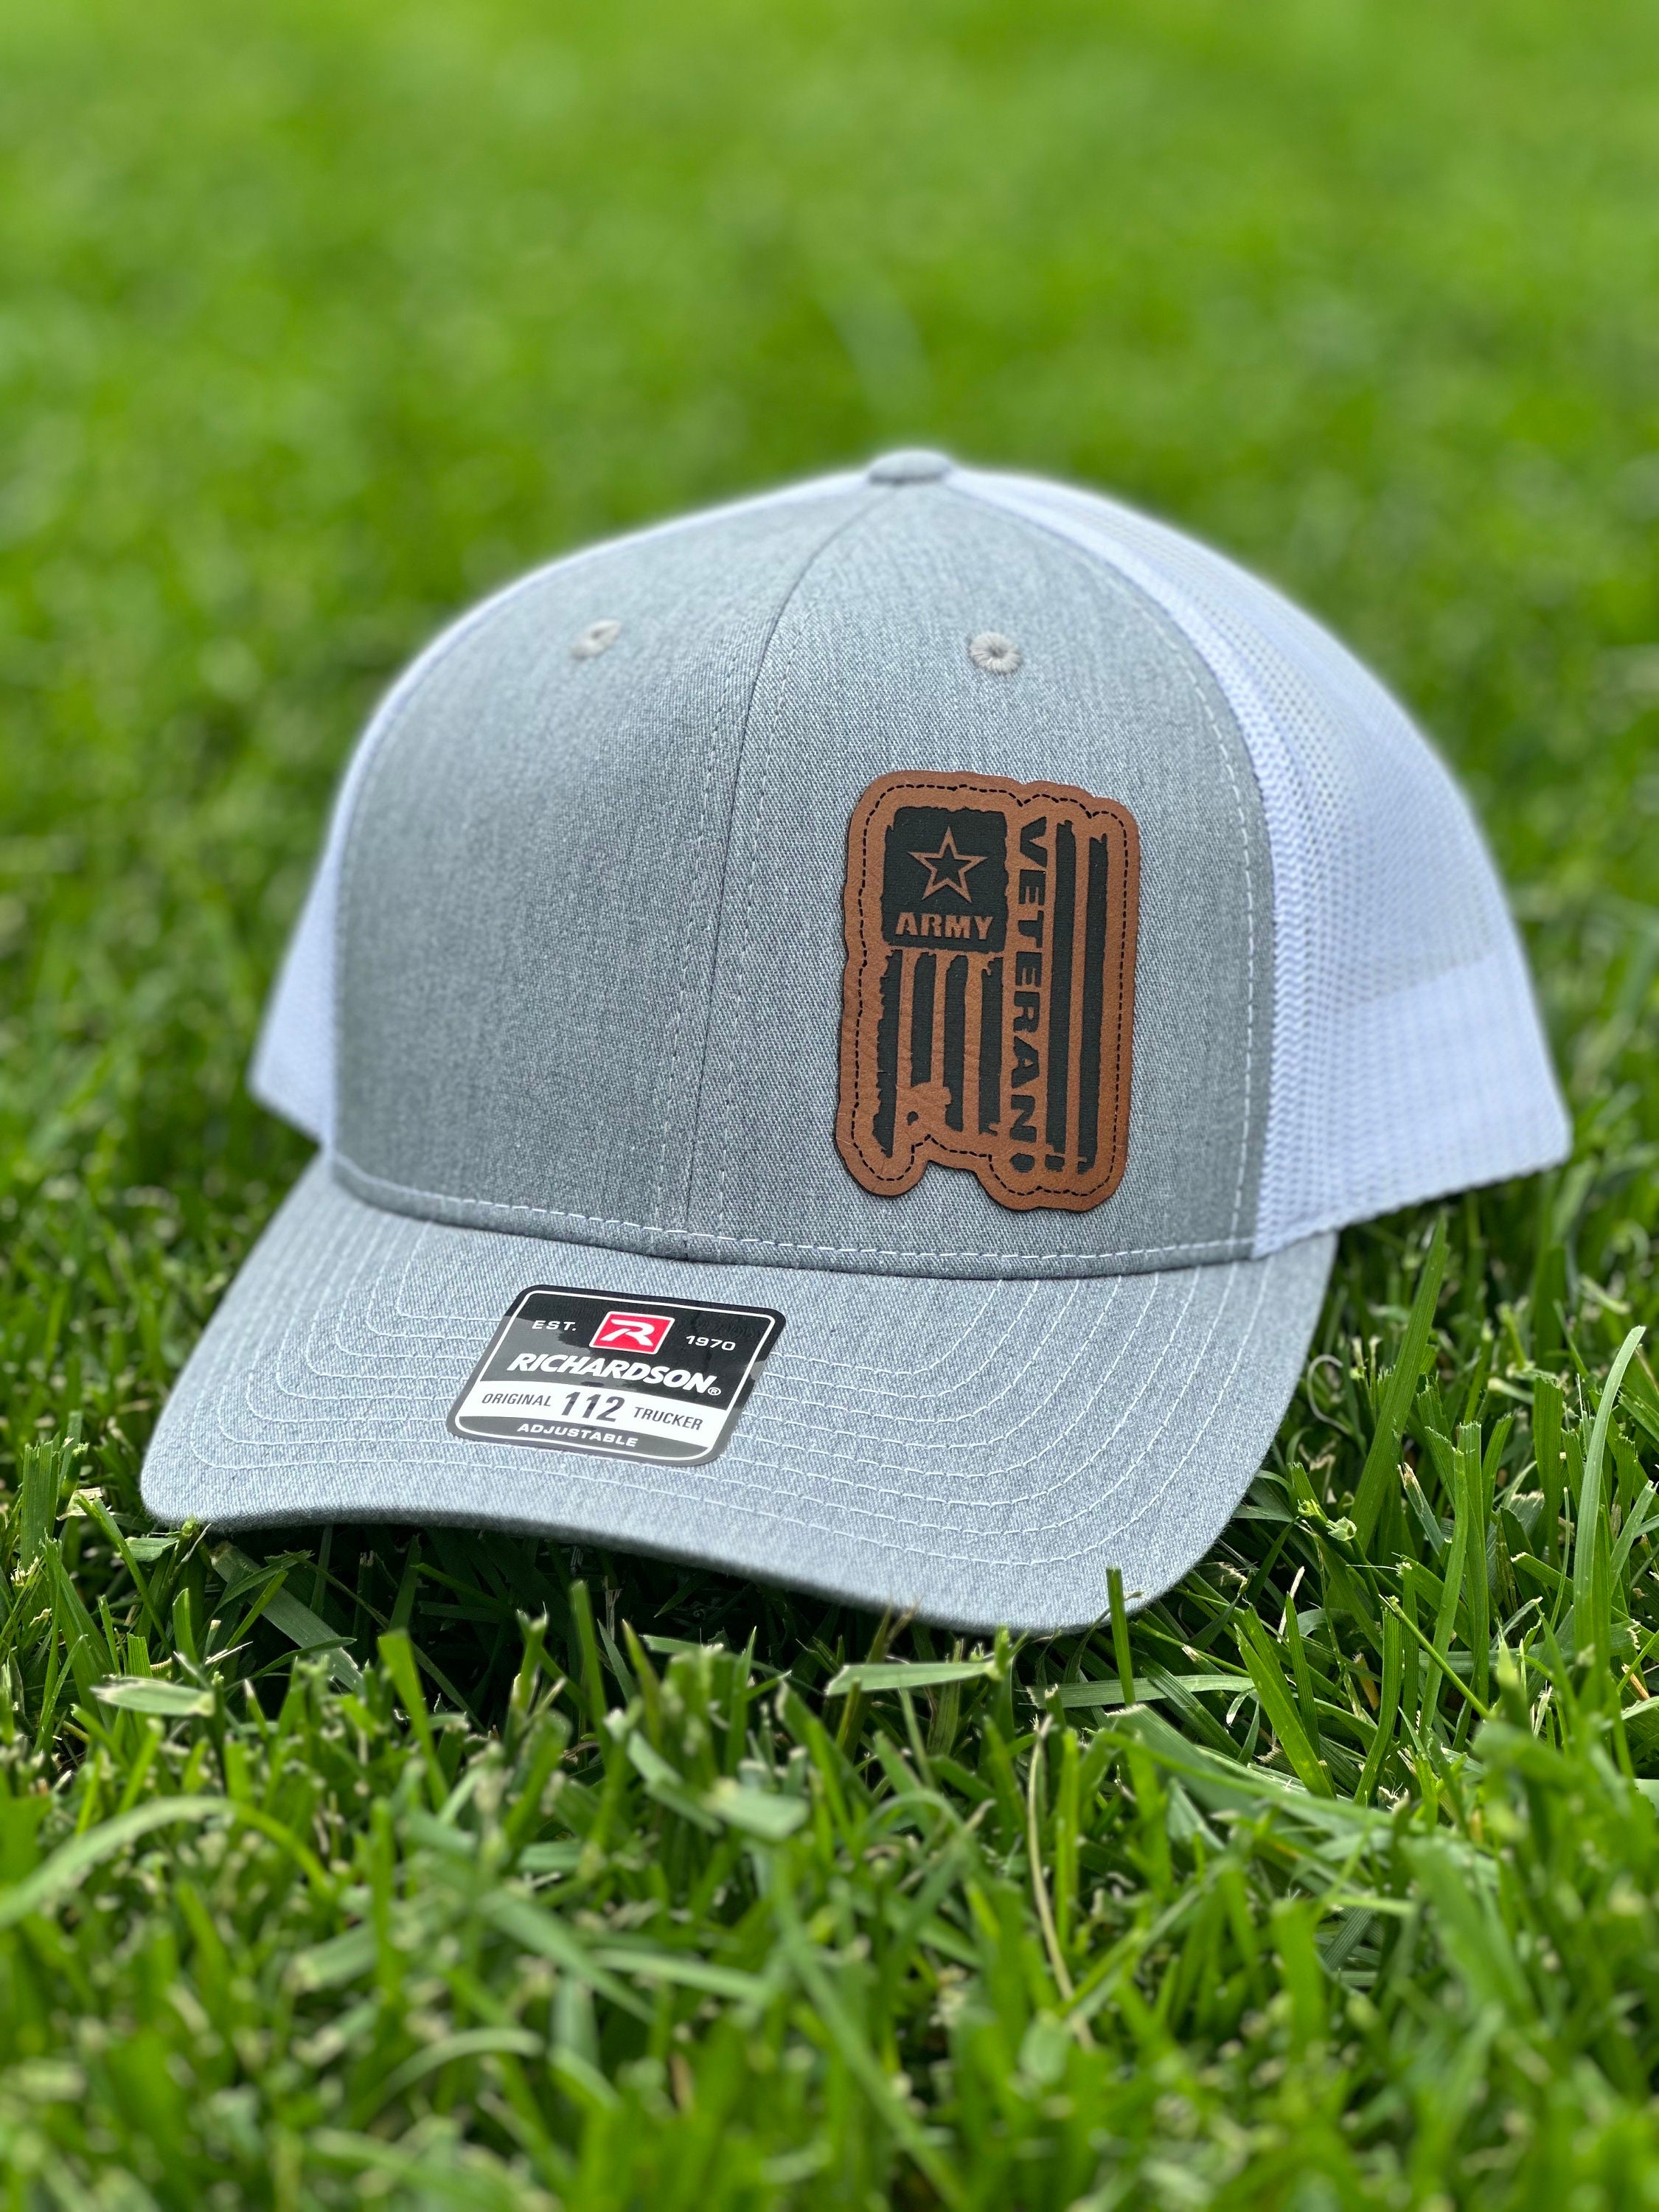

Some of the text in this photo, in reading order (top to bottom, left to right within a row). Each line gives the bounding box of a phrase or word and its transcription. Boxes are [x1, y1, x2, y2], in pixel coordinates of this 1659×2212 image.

[894, 911, 994, 940] ARMY
[1009, 815, 1048, 1144] VETERAN
[531, 1319, 737, 1351] EST. 1970
[481, 1391, 703, 1431] ORIGINAL 112 TRUCKER
[516, 1423, 639, 1448] ADJUSTABLE
